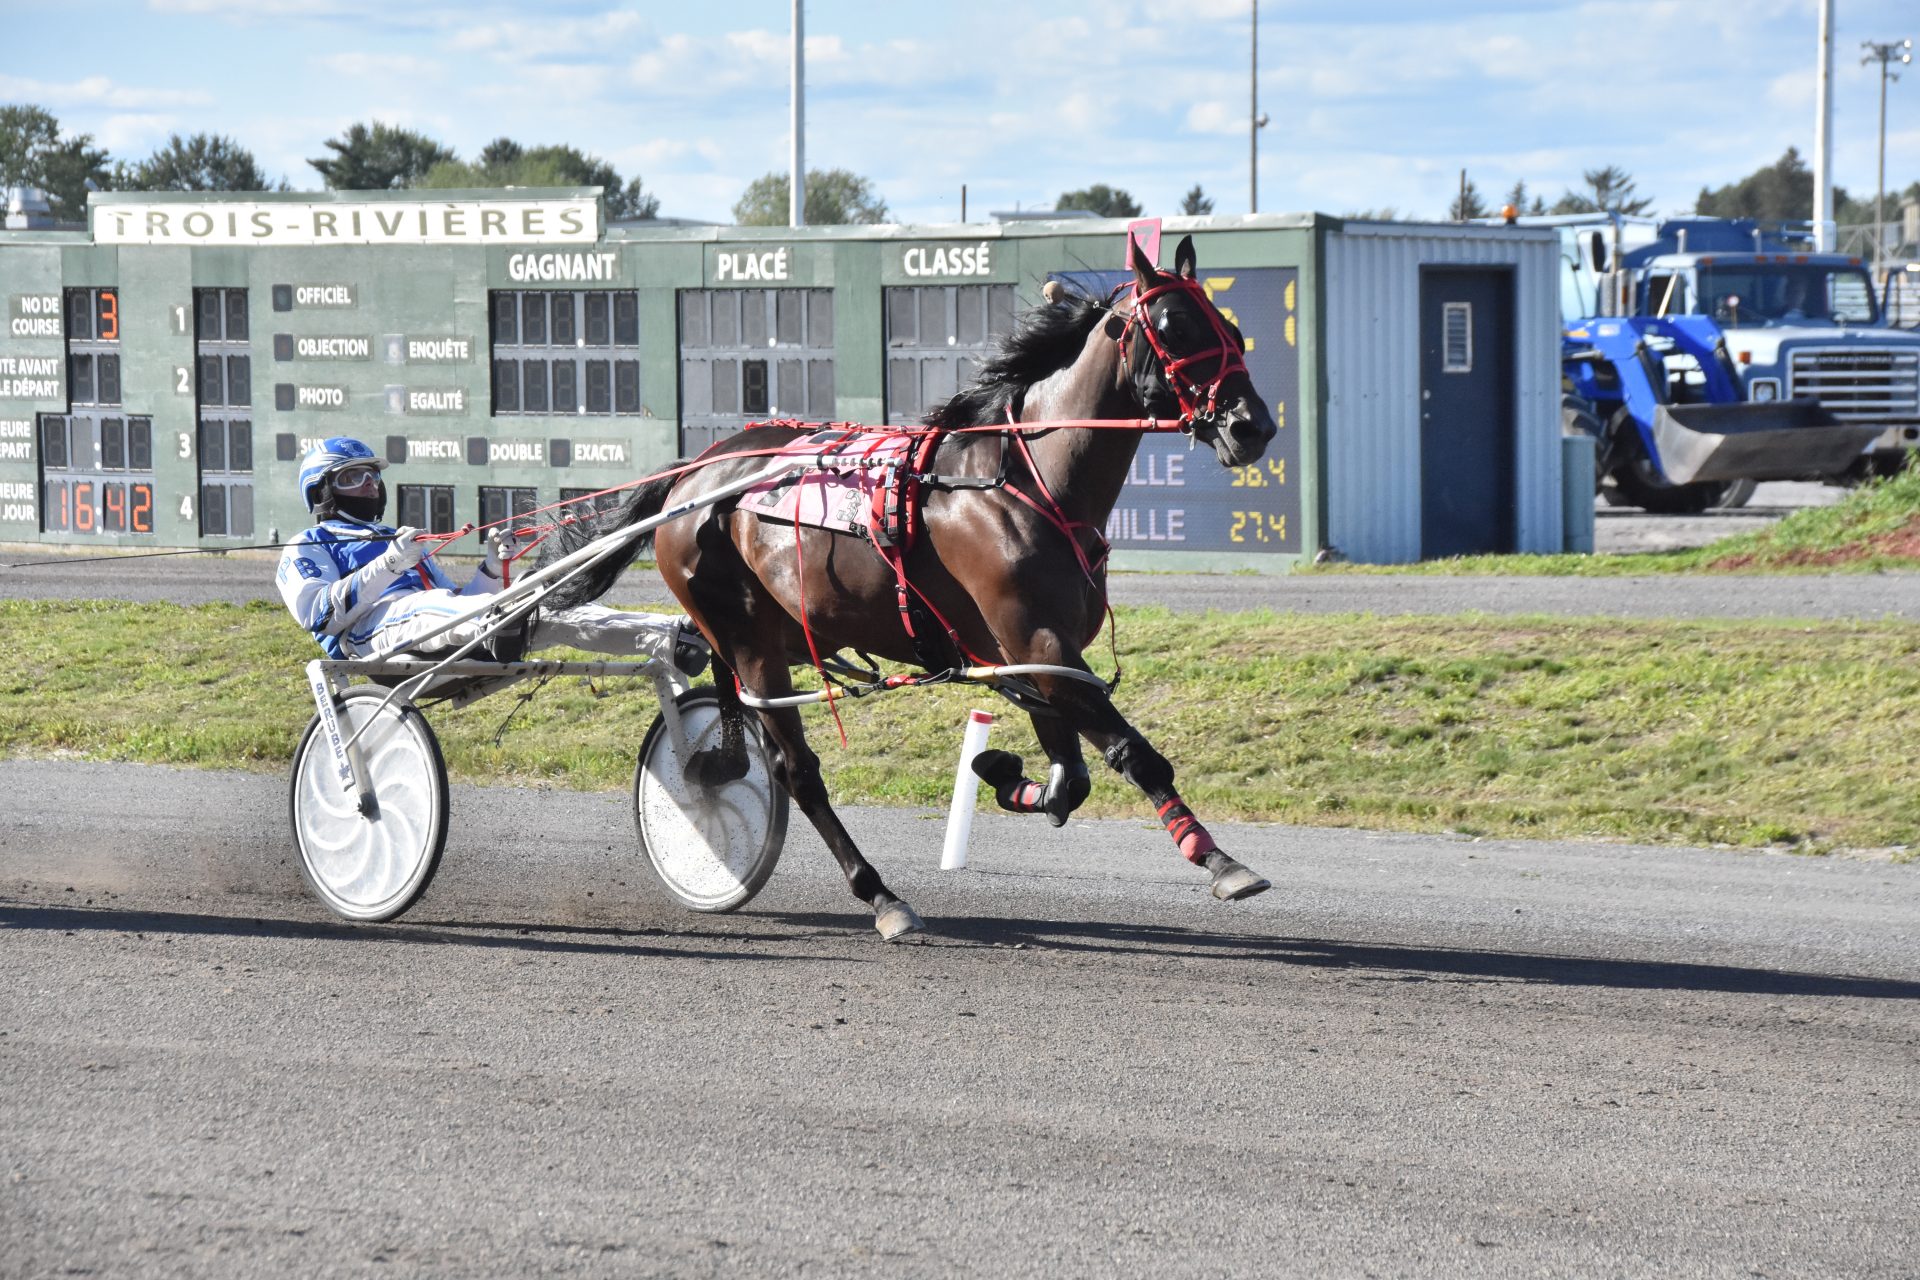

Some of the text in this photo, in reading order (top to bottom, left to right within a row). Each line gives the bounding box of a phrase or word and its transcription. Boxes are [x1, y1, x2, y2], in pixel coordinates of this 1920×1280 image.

[108, 204, 583, 238] TROIS-RIVIÈRES
[509, 253, 616, 281] GAGNANT
[718, 248, 787, 281] PLACÉ
[904, 242, 990, 277] CLASSÉ
[21, 297, 60, 314] NO DE
[297, 286, 351, 304] OFFICIEL
[101, 293, 118, 338] 3
[176, 306, 185, 332] 1
[12, 318, 60, 335] COURSE
[298, 338, 368, 357] OBJECTION
[409, 338, 469, 359] ENQUÊTE
[0, 358, 58, 375] TE AVANT
[12, 377, 59, 397] DÉPART
[177, 368, 189, 392] 2
[299, 387, 343, 406] PHOTO
[410, 390, 463, 411] EGALITÉ
[179, 433, 191, 458] 3
[407, 440, 461, 458] TRIFECTA
[490, 443, 542, 461] DOUBLE
[575, 443, 625, 461] EXACTA
[2, 504, 35, 521] JOUR
[180, 496, 193, 520] 4
[1105, 508, 1286, 542] MILLE 27.4
